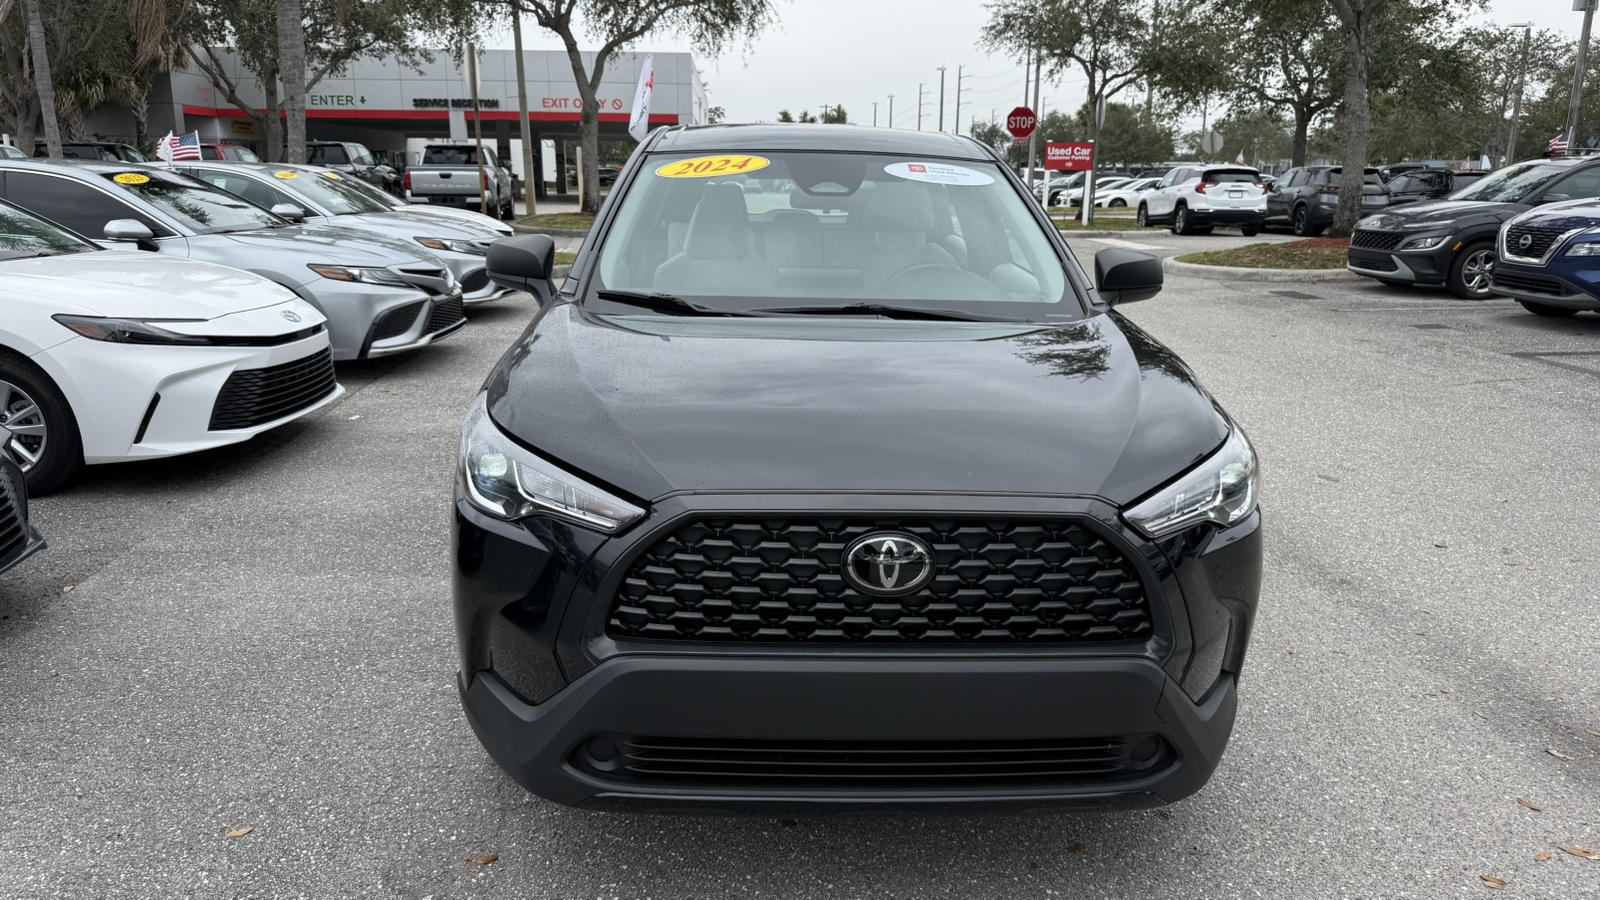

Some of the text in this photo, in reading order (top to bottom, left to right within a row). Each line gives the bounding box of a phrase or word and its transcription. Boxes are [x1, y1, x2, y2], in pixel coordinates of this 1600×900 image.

[310, 95, 354, 106] ENTER
[412, 98, 499, 109] SERVICE RECETION
[542, 98, 607, 109] EXIT OY
[1008, 116, 1035, 129] STOP
[1047, 146, 1092, 155] Used Car
[673, 157, 752, 175] 2024
